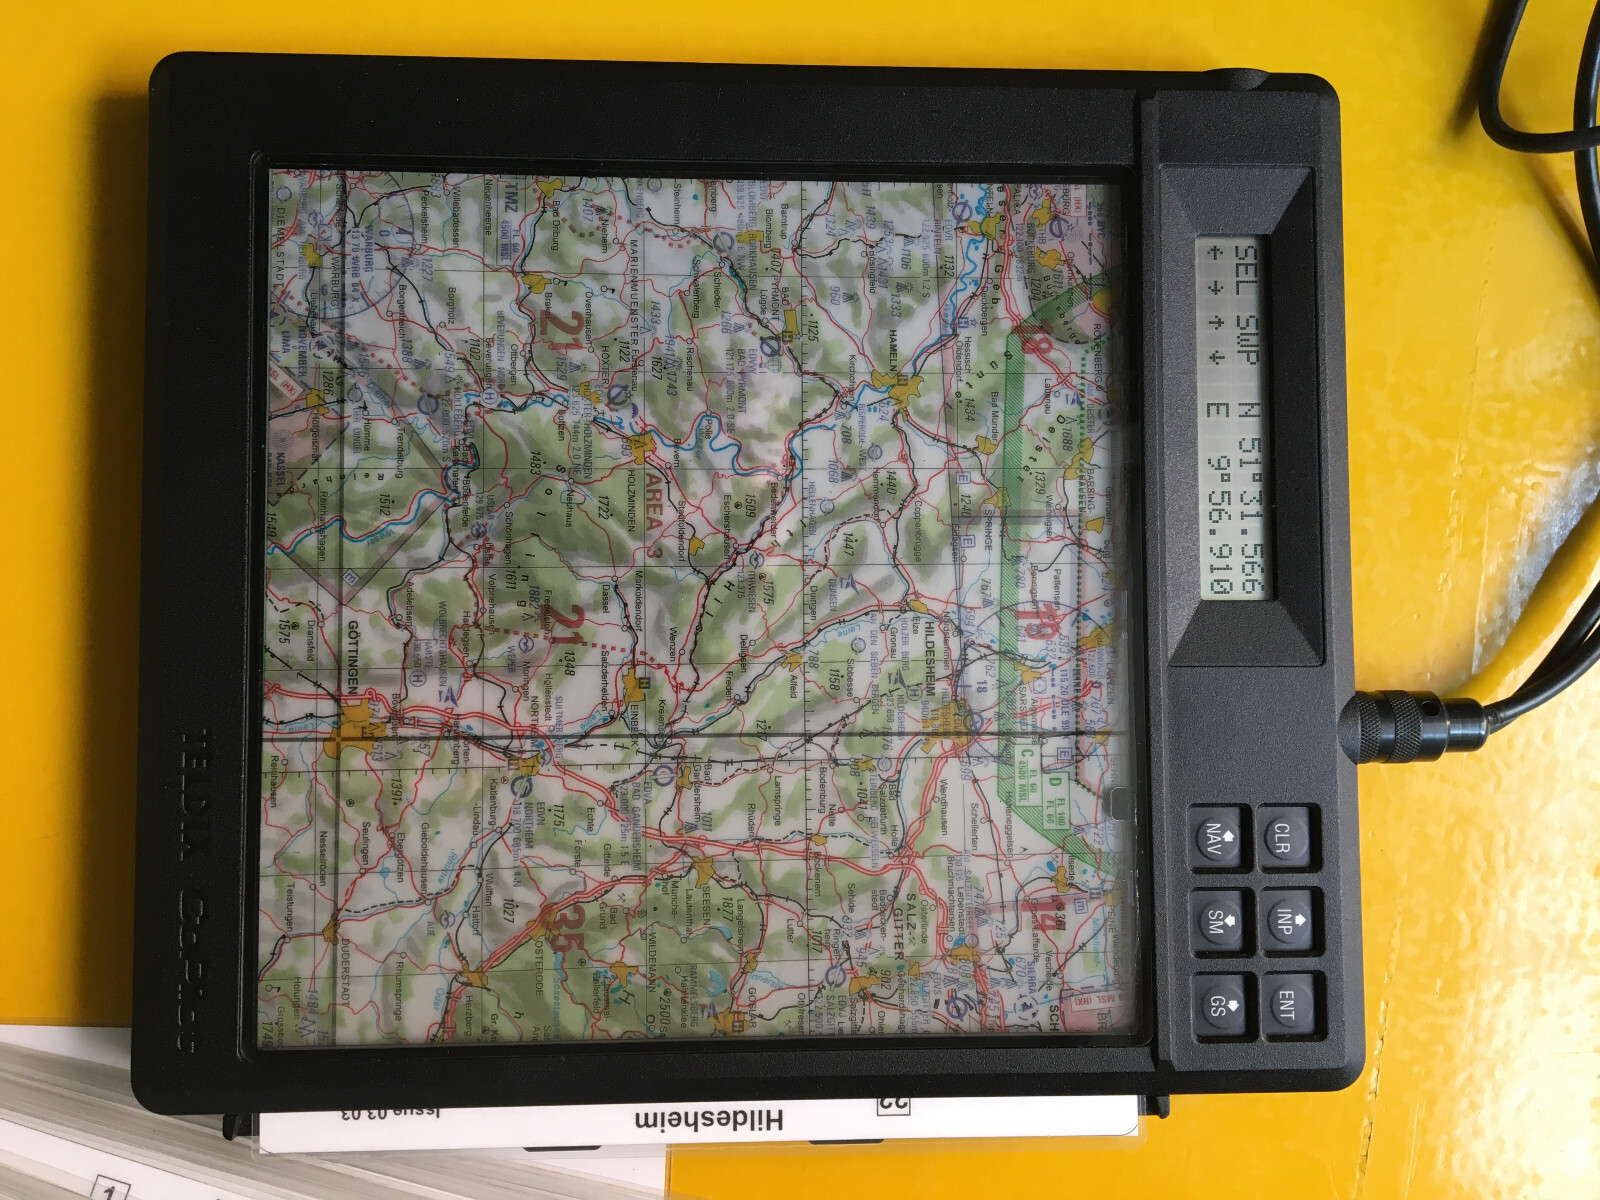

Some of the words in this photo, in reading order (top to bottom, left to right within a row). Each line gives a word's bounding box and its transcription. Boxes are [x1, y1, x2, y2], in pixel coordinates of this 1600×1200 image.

[505, 184, 518, 212] TMZ
[421, 191, 429, 243] Peckelsheim
[764, 209, 773, 248] Blomberg
[276, 208, 284, 287] DIEMELSTADT
[365, 226, 373, 272] WARBURG
[945, 255, 954, 277] 1132
[1236, 246, 1258, 295] SEL
[692, 260, 700, 318] Schwalenberg
[1031, 278, 1041, 301] 1204
[448, 287, 456, 324] Borgholz
[540, 310, 584, 350] 21
[808, 320, 818, 342] 1125
[1236, 314, 1259, 365] SWP
[510, 344, 518, 386] Ottbergen
[652, 356, 662, 380] 1627
[323, 370, 333, 395] 1286
[667, 372, 677, 396] 1743
[965, 398, 975, 421] 1434
[1207, 402, 1229, 418] E
[1238, 402, 1260, 418] N
[842, 425, 852, 444] 708
[1062, 428, 1073, 451] 1688
[396, 428, 404, 478] Trendelburg
[530, 451, 541, 475] 1483
[887, 470, 897, 494] 1440
[380, 494, 390, 515] 1512
[599, 495, 609, 520] 1722
[646, 473, 663, 531] AREA
[678, 501, 686, 562] Stadtoldendorf
[723, 495, 731, 559] Eschershausen
[647, 548, 663, 558] 3
[844, 532, 854, 556] 1447
[506, 569, 517, 590] 1611
[764, 580, 774, 604] 1575
[1053, 569, 1061, 611] Pattensen
[488, 574, 496, 634] Volpriehausen
[635, 571, 643, 631] Markoldendorf
[809, 586, 817, 620] Duingen
[279, 619, 289, 644] 1575
[462, 611, 470, 658] Hardegsen
[541, 604, 585, 644] 21
[348, 621, 360, 694] GÖTTINGEN
[669, 627, 677, 662] Wenzen
[740, 635, 748, 672] Delligsen
[925, 622, 935, 696] HILDESHEIM
[565, 651, 575, 676] 1348
[1021, 749, 1033, 757] C
[392, 778, 402, 801] 1391
[819, 767, 827, 813] Bodenburg
[1030, 783, 1037, 793] 60
[1049, 777, 1061, 786] D
[554, 804, 564, 826] 1175
[1046, 814, 1054, 824] 60
[362, 822, 370, 865] Seulingen
[1206, 823, 1221, 854] NAV
[1274, 823, 1290, 853] CLR
[319, 831, 327, 886] Nesselröden
[421, 823, 429, 894] Gieboldehausen
[814, 852, 822, 896] Bockenem
[286, 883, 295, 932] Teistungen
[504, 898, 514, 923] 1027
[723, 897, 732, 921] 1877
[907, 894, 916, 935] SALZ-
[1208, 910, 1223, 934] SM
[1277, 909, 1292, 935] INP
[736, 899, 744, 955] Langelsheim
[894, 908, 904, 960] GITTER
[394, 962, 403, 1021] Rhumspringe
[1210, 996, 1225, 1017] GS
[1279, 990, 1294, 1020] ENT
[465, 996, 473, 1036] Herzberg
[660, 997, 670, 1024] 2500
[635, 1110, 783, 1133] Hildesheim
